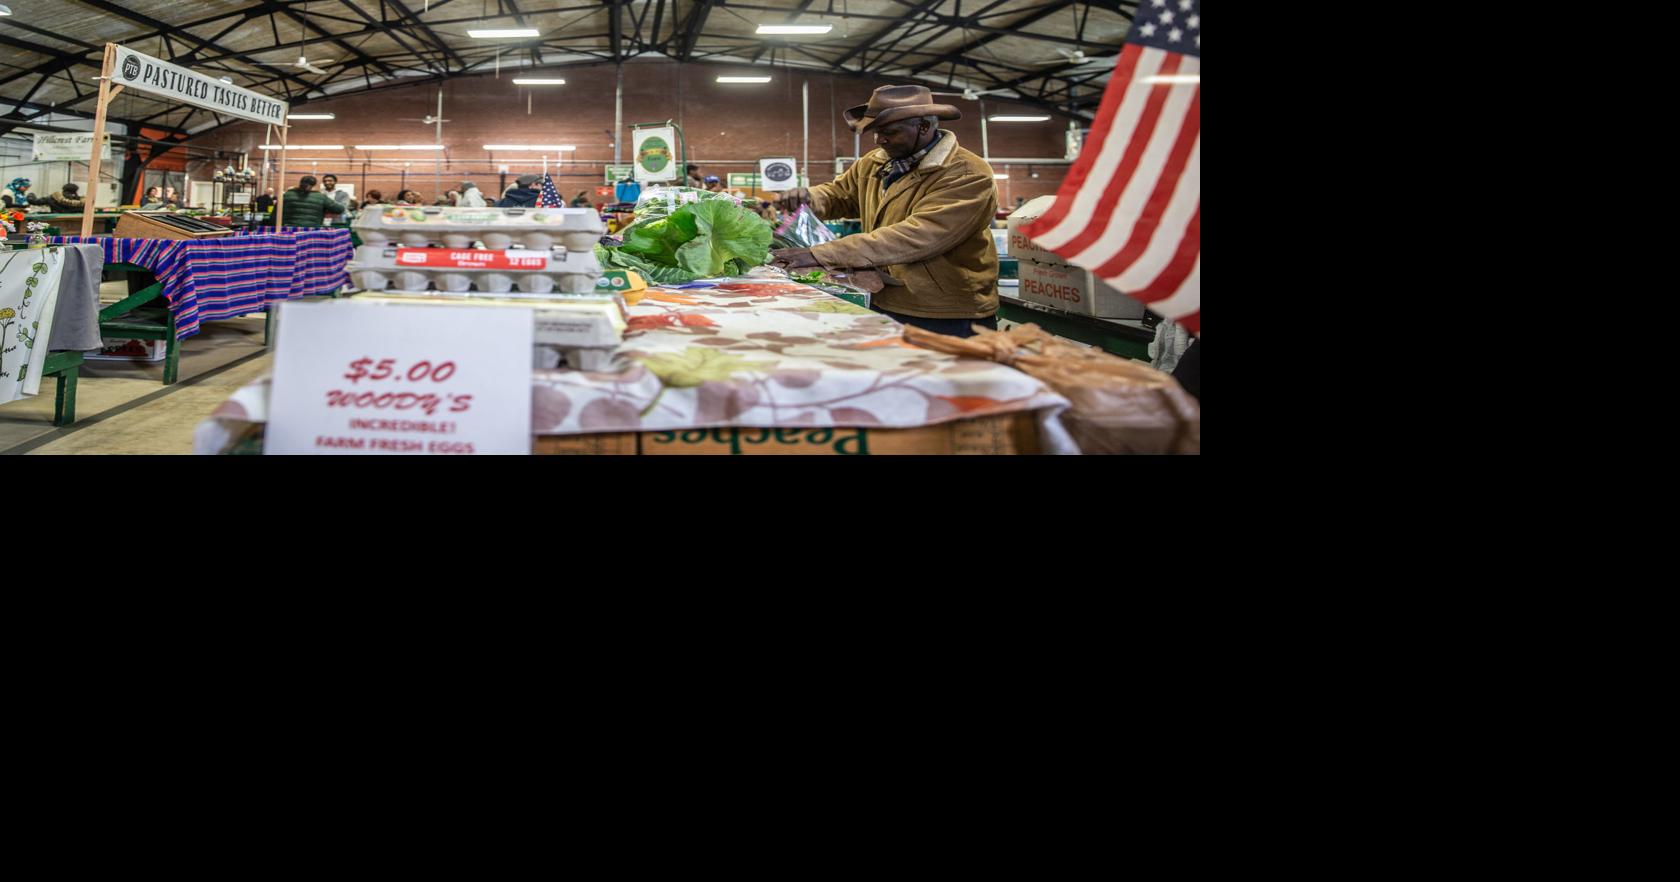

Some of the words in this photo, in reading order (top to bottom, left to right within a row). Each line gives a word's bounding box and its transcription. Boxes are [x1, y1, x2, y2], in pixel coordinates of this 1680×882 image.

[124, 62, 139, 76] PTB
[143, 63, 208, 99] PASTURED
[213, 85, 247, 111] TASTES
[250, 97, 282, 119] BETTER
[450, 252, 472, 261] CAGE
[474, 252, 495, 262] FREE
[521, 257, 542, 267] EGGS
[1023, 279, 1081, 303] PEACHES
[344, 356, 457, 383] $5.00
[326, 389, 473, 415] WOODY'S
[349, 418, 457, 434] INCREDIBLE!
[315, 435, 365, 449] FARM
[369, 438, 423, 451] FRESH
[428, 441, 476, 454] EGGS
